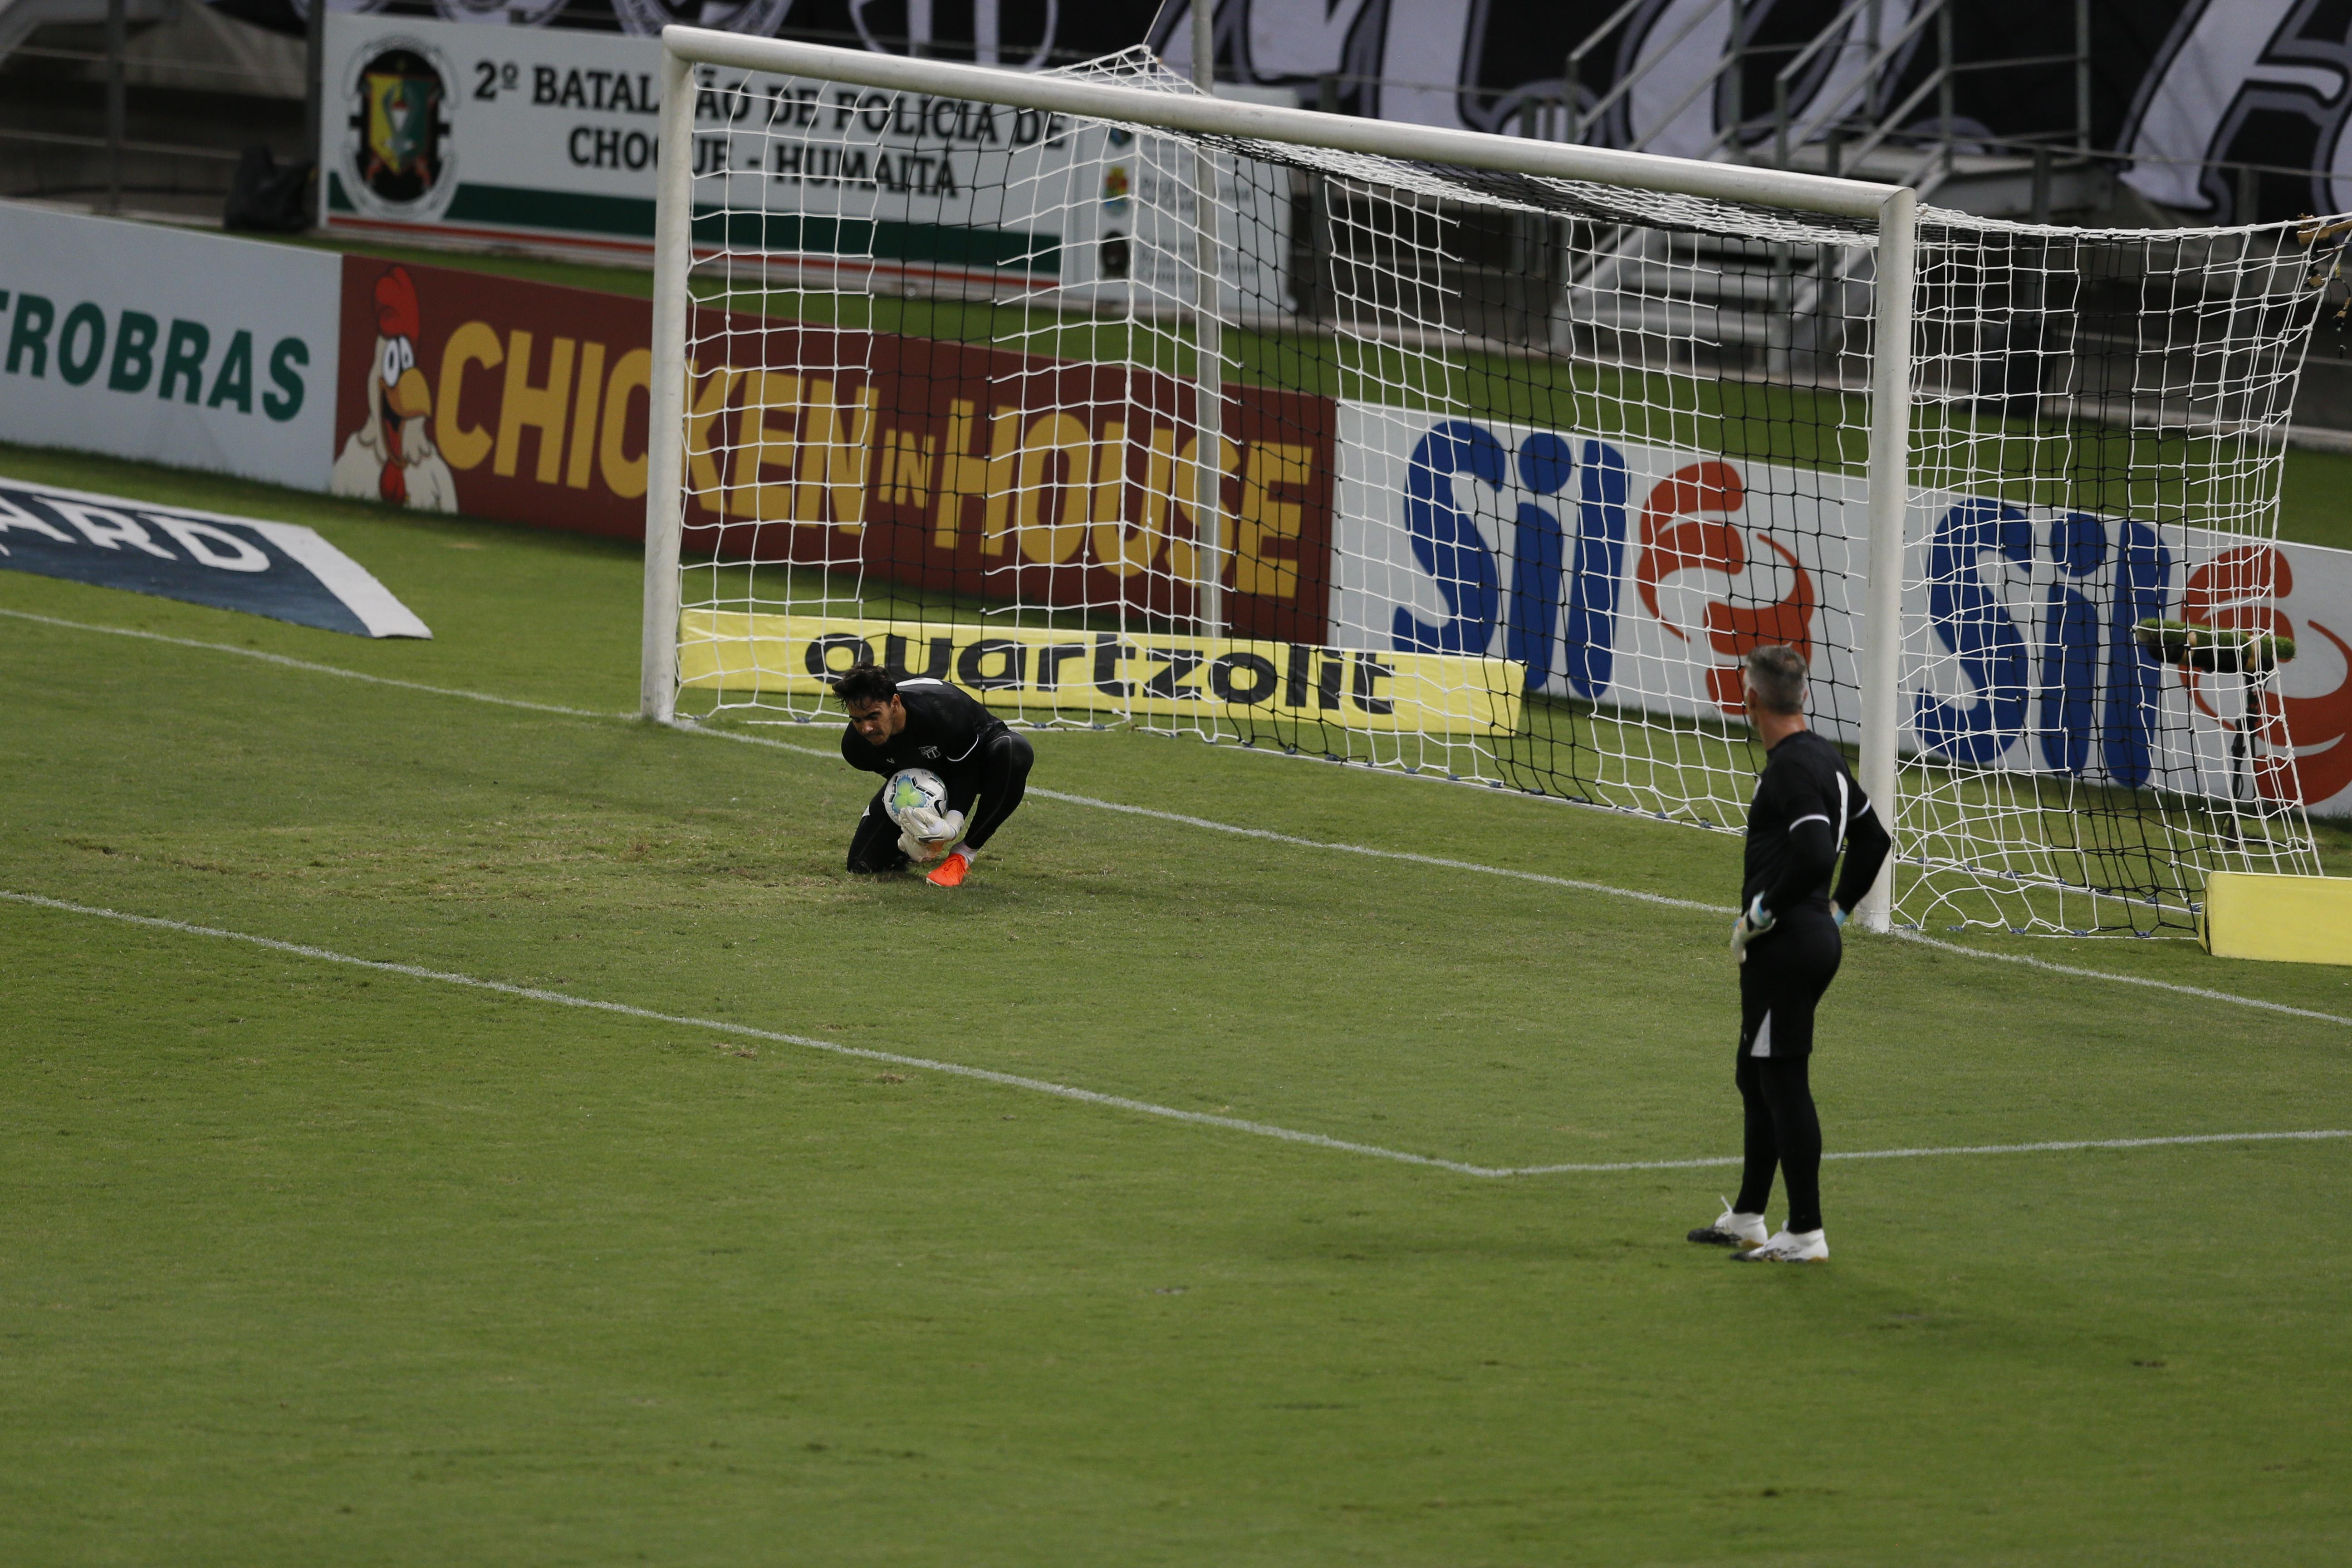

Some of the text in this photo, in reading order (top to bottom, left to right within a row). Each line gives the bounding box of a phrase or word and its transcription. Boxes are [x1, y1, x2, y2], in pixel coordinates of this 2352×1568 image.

[474, 59, 518, 101] 2º
[533, 64, 750, 122] BATALÃO
[766, 85, 818, 129] DE
[1014, 108, 1065, 149] DE
[568, 125, 730, 178] CHOUE
[0, 289, 310, 422] ROBRAS
[435, 320, 1313, 598] CHICKEN IN HOUSE
